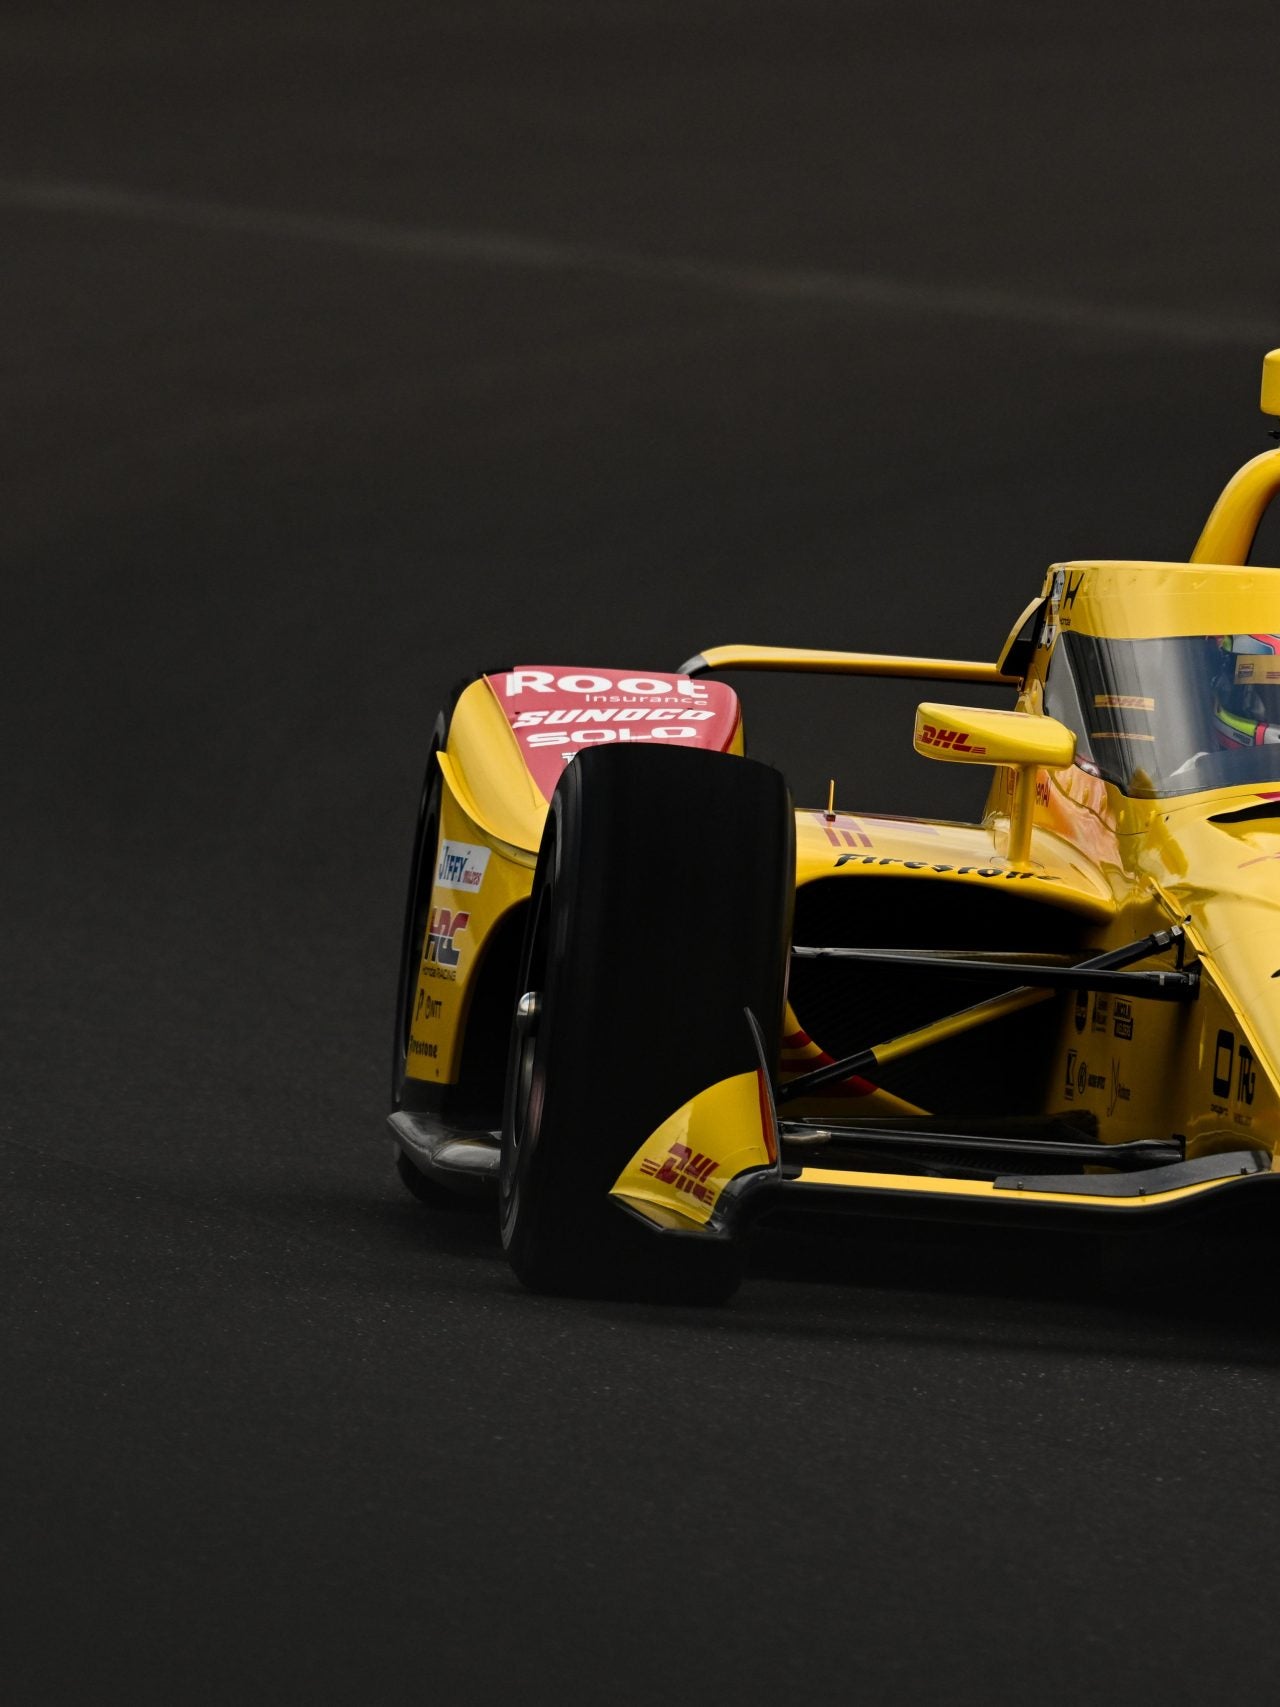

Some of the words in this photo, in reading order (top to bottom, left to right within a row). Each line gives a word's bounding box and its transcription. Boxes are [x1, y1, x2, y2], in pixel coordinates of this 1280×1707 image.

[585, 694, 708, 706] Insurance
[512, 708, 716, 729] SUNOCO
[526, 726, 697, 748] SOLO
[922, 724, 972, 753] DHL
[834, 853, 1062, 881] Firestone
